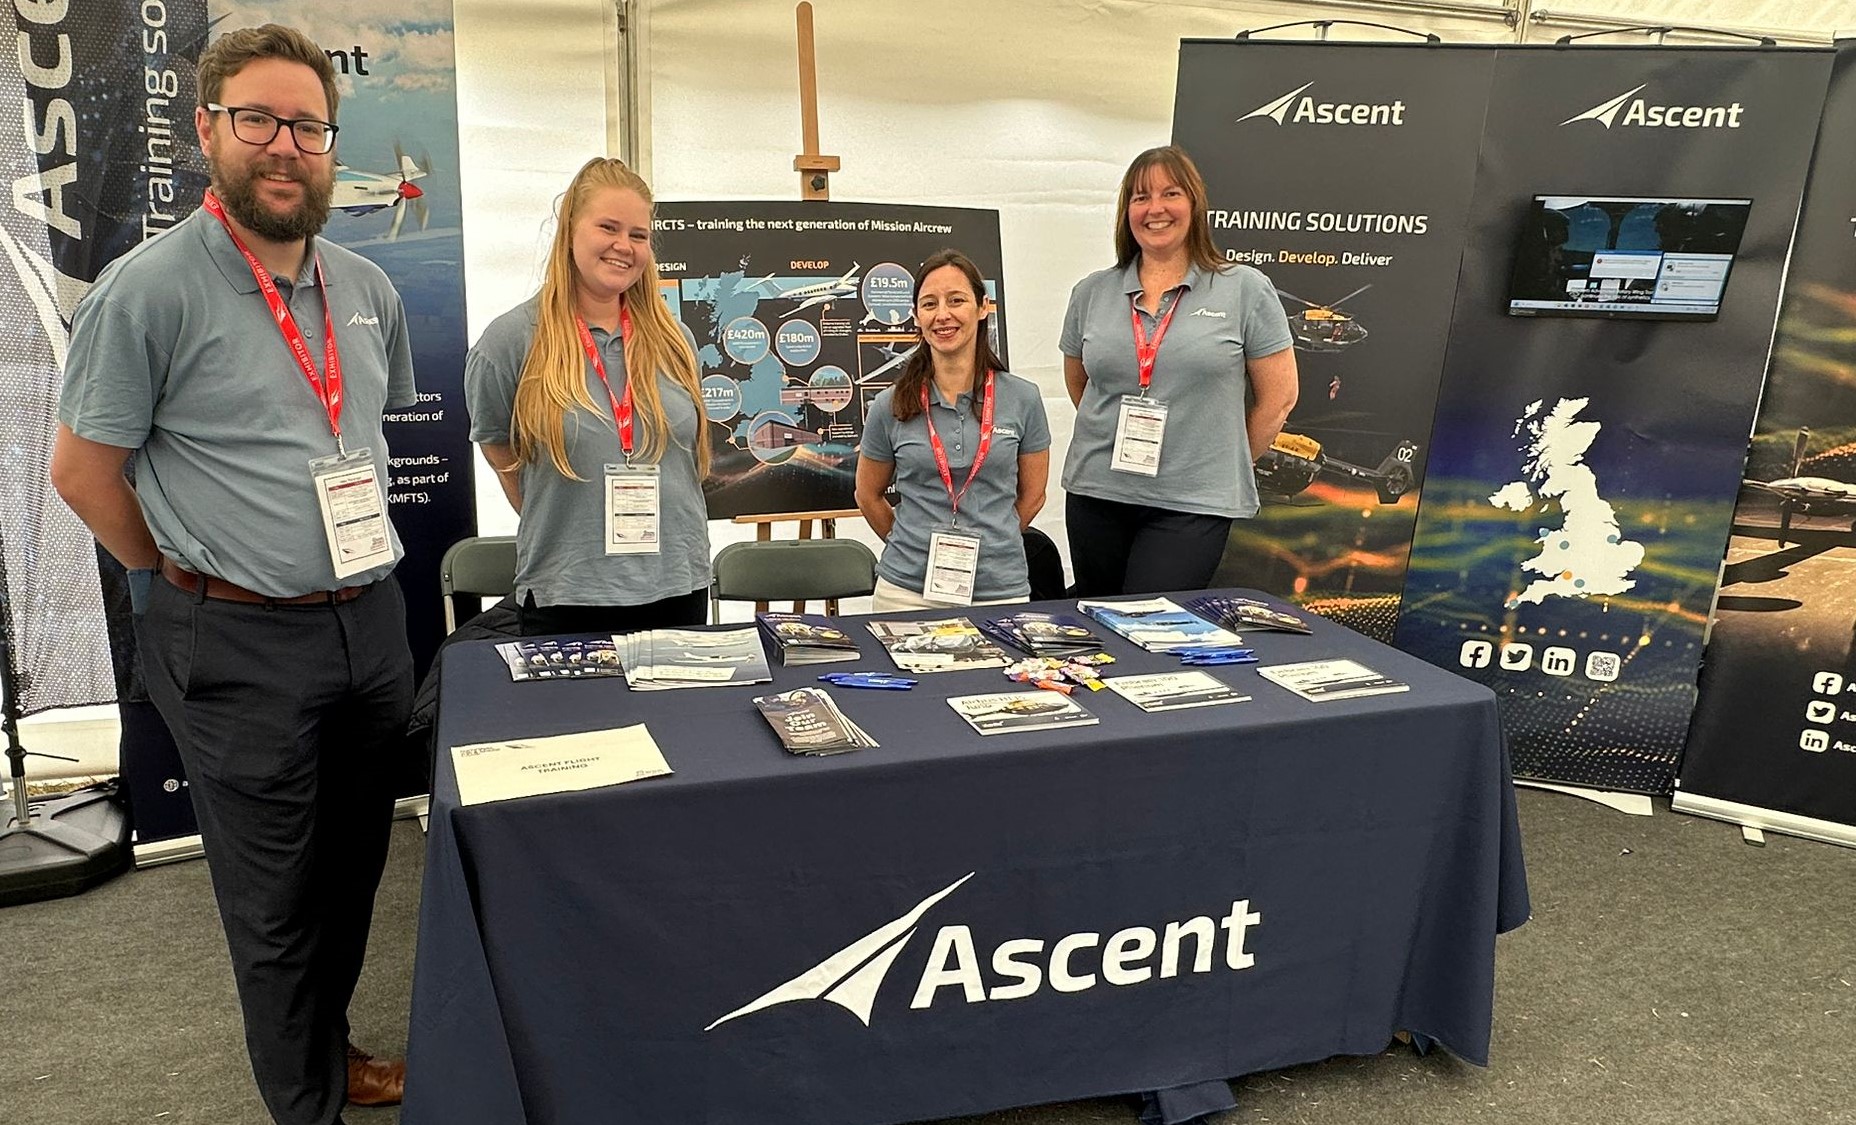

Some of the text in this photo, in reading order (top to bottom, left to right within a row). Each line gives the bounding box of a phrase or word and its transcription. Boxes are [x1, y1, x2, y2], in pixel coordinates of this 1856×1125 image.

[1293, 96, 1405, 125] Ascent
[1622, 99, 1744, 128] Ascent
[697, 219, 744, 232] training
[745, 219, 765, 230] the
[767, 220, 793, 231] next
[795, 219, 856, 232] generation
[857, 220, 870, 231] of
[871, 220, 911, 232] Mission
[913, 222, 952, 234] Aircrew
[1207, 210, 1428, 235] TRAINING SOLUTIONS
[1226, 249, 1393, 266] Design. Develop. Deliver
[655, 262, 687, 272] DESIGN
[790, 261, 830, 270] DEVELOP
[870, 277, 908, 289] £19.5m
[727, 329, 765, 340] £420m
[779, 333, 814, 343] £180m
[292, 338, 317, 381] EXHIBITOR
[382, 410, 444, 422] neration of
[388, 455, 440, 468] kgrounds
[1398, 447, 1413, 462] 02
[397, 476, 410, 485] as
[412, 474, 435, 486] part
[437, 472, 449, 483] of
[784, 713, 816, 723] Join
[520, 756, 601, 771] ASCENT FLIGHT
[538, 763, 588, 774] TRAINING
[910, 899, 1261, 1010] Ascent
